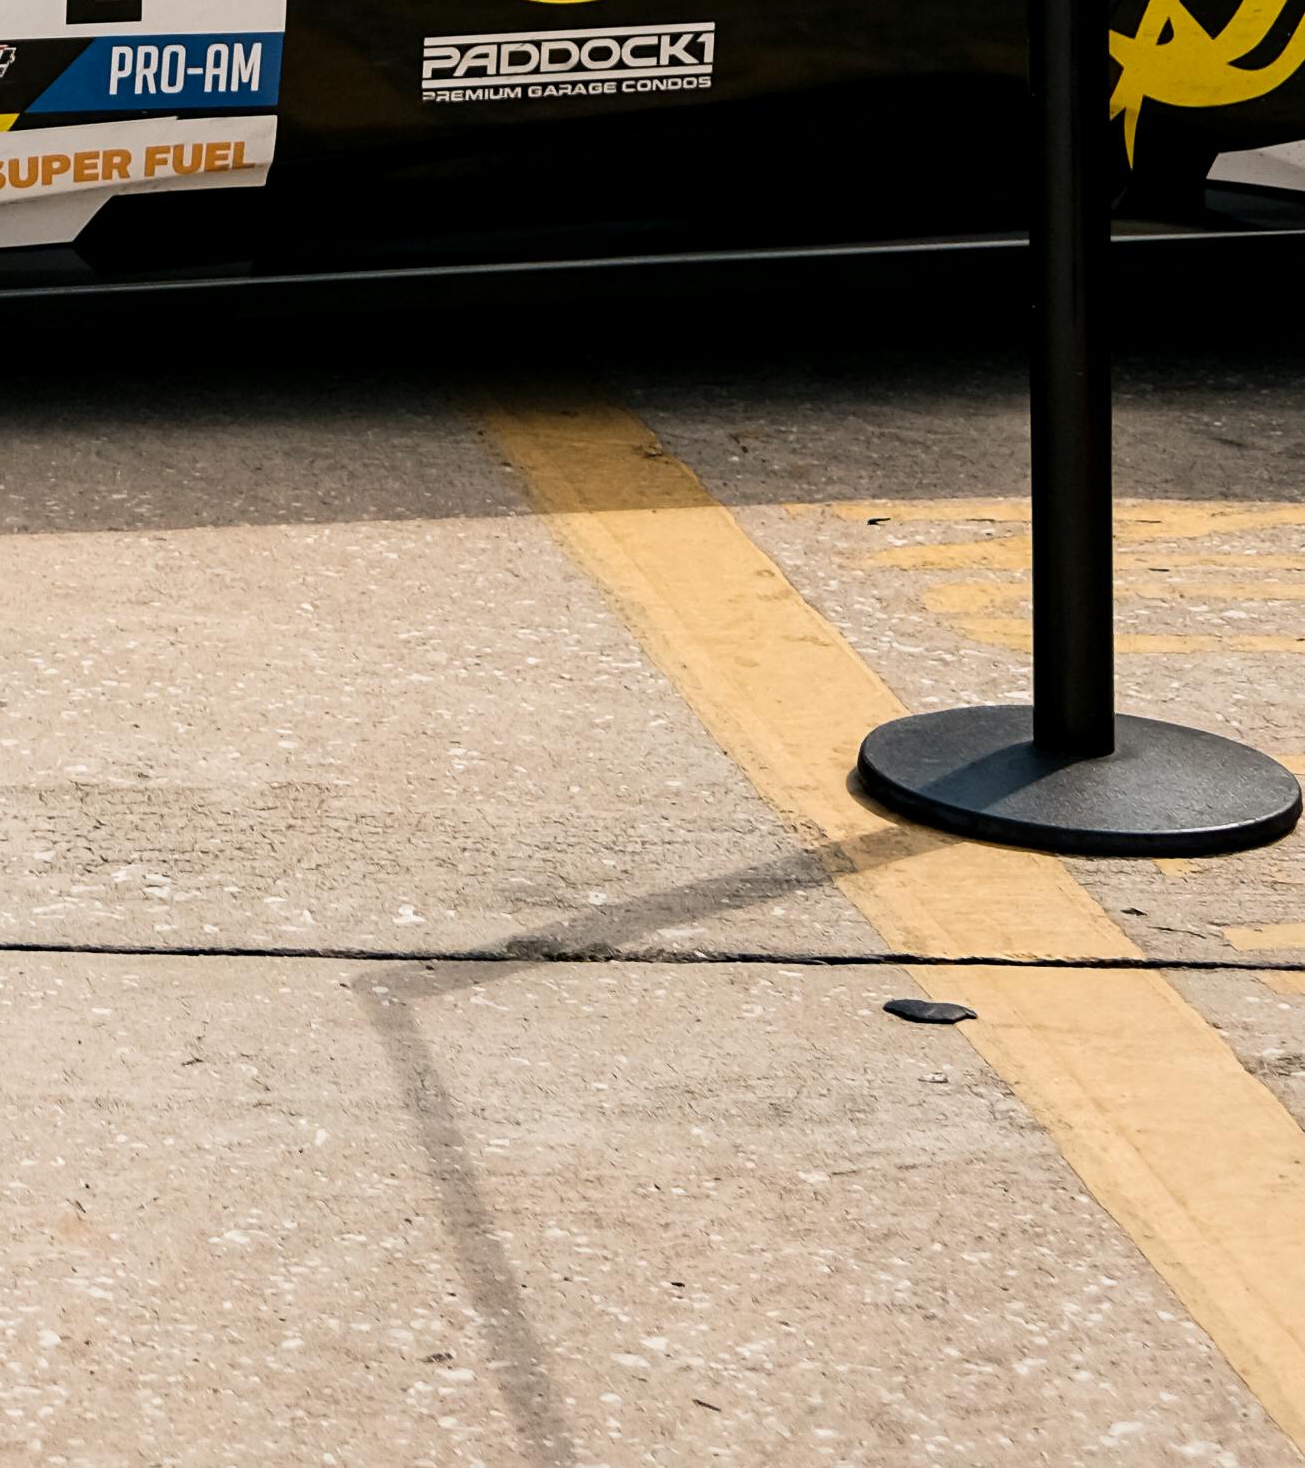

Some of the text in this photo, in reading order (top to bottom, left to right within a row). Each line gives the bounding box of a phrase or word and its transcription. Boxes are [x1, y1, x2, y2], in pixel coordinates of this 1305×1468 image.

[108, 42, 263, 96] PRO-AM
[422, 32, 715, 79] PADDOCK1
[422, 75, 713, 102] PREMIUM GARAGE CONDOS
[144, 141, 256, 177] FUEL
